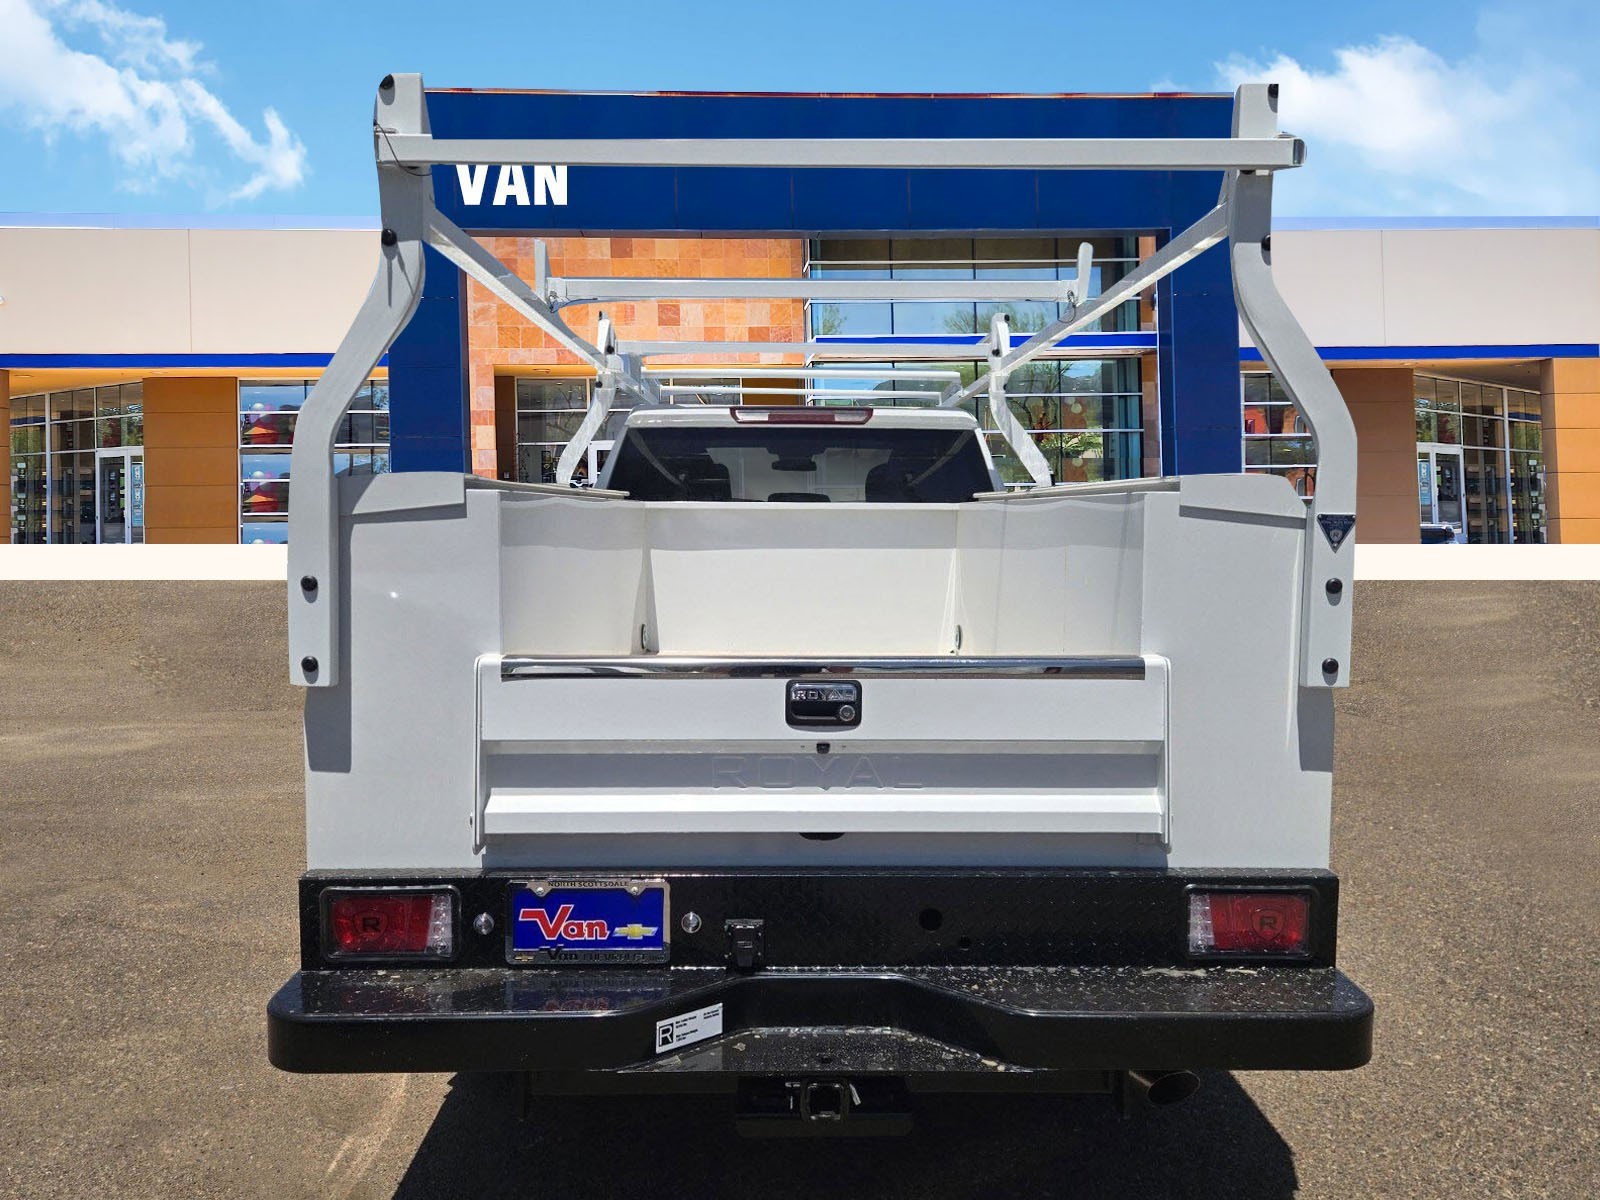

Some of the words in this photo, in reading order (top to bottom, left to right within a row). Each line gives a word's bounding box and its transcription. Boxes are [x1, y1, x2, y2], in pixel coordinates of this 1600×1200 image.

[455, 164, 568, 206] VAN
[794, 687, 855, 701] ROYAL
[711, 755, 923, 790] ROYAL
[547, 880, 576, 888] NORTH
[577, 880, 630, 888] SCOTTSDALE
[518, 904, 611, 941] Van
[659, 1024, 673, 1046] R
